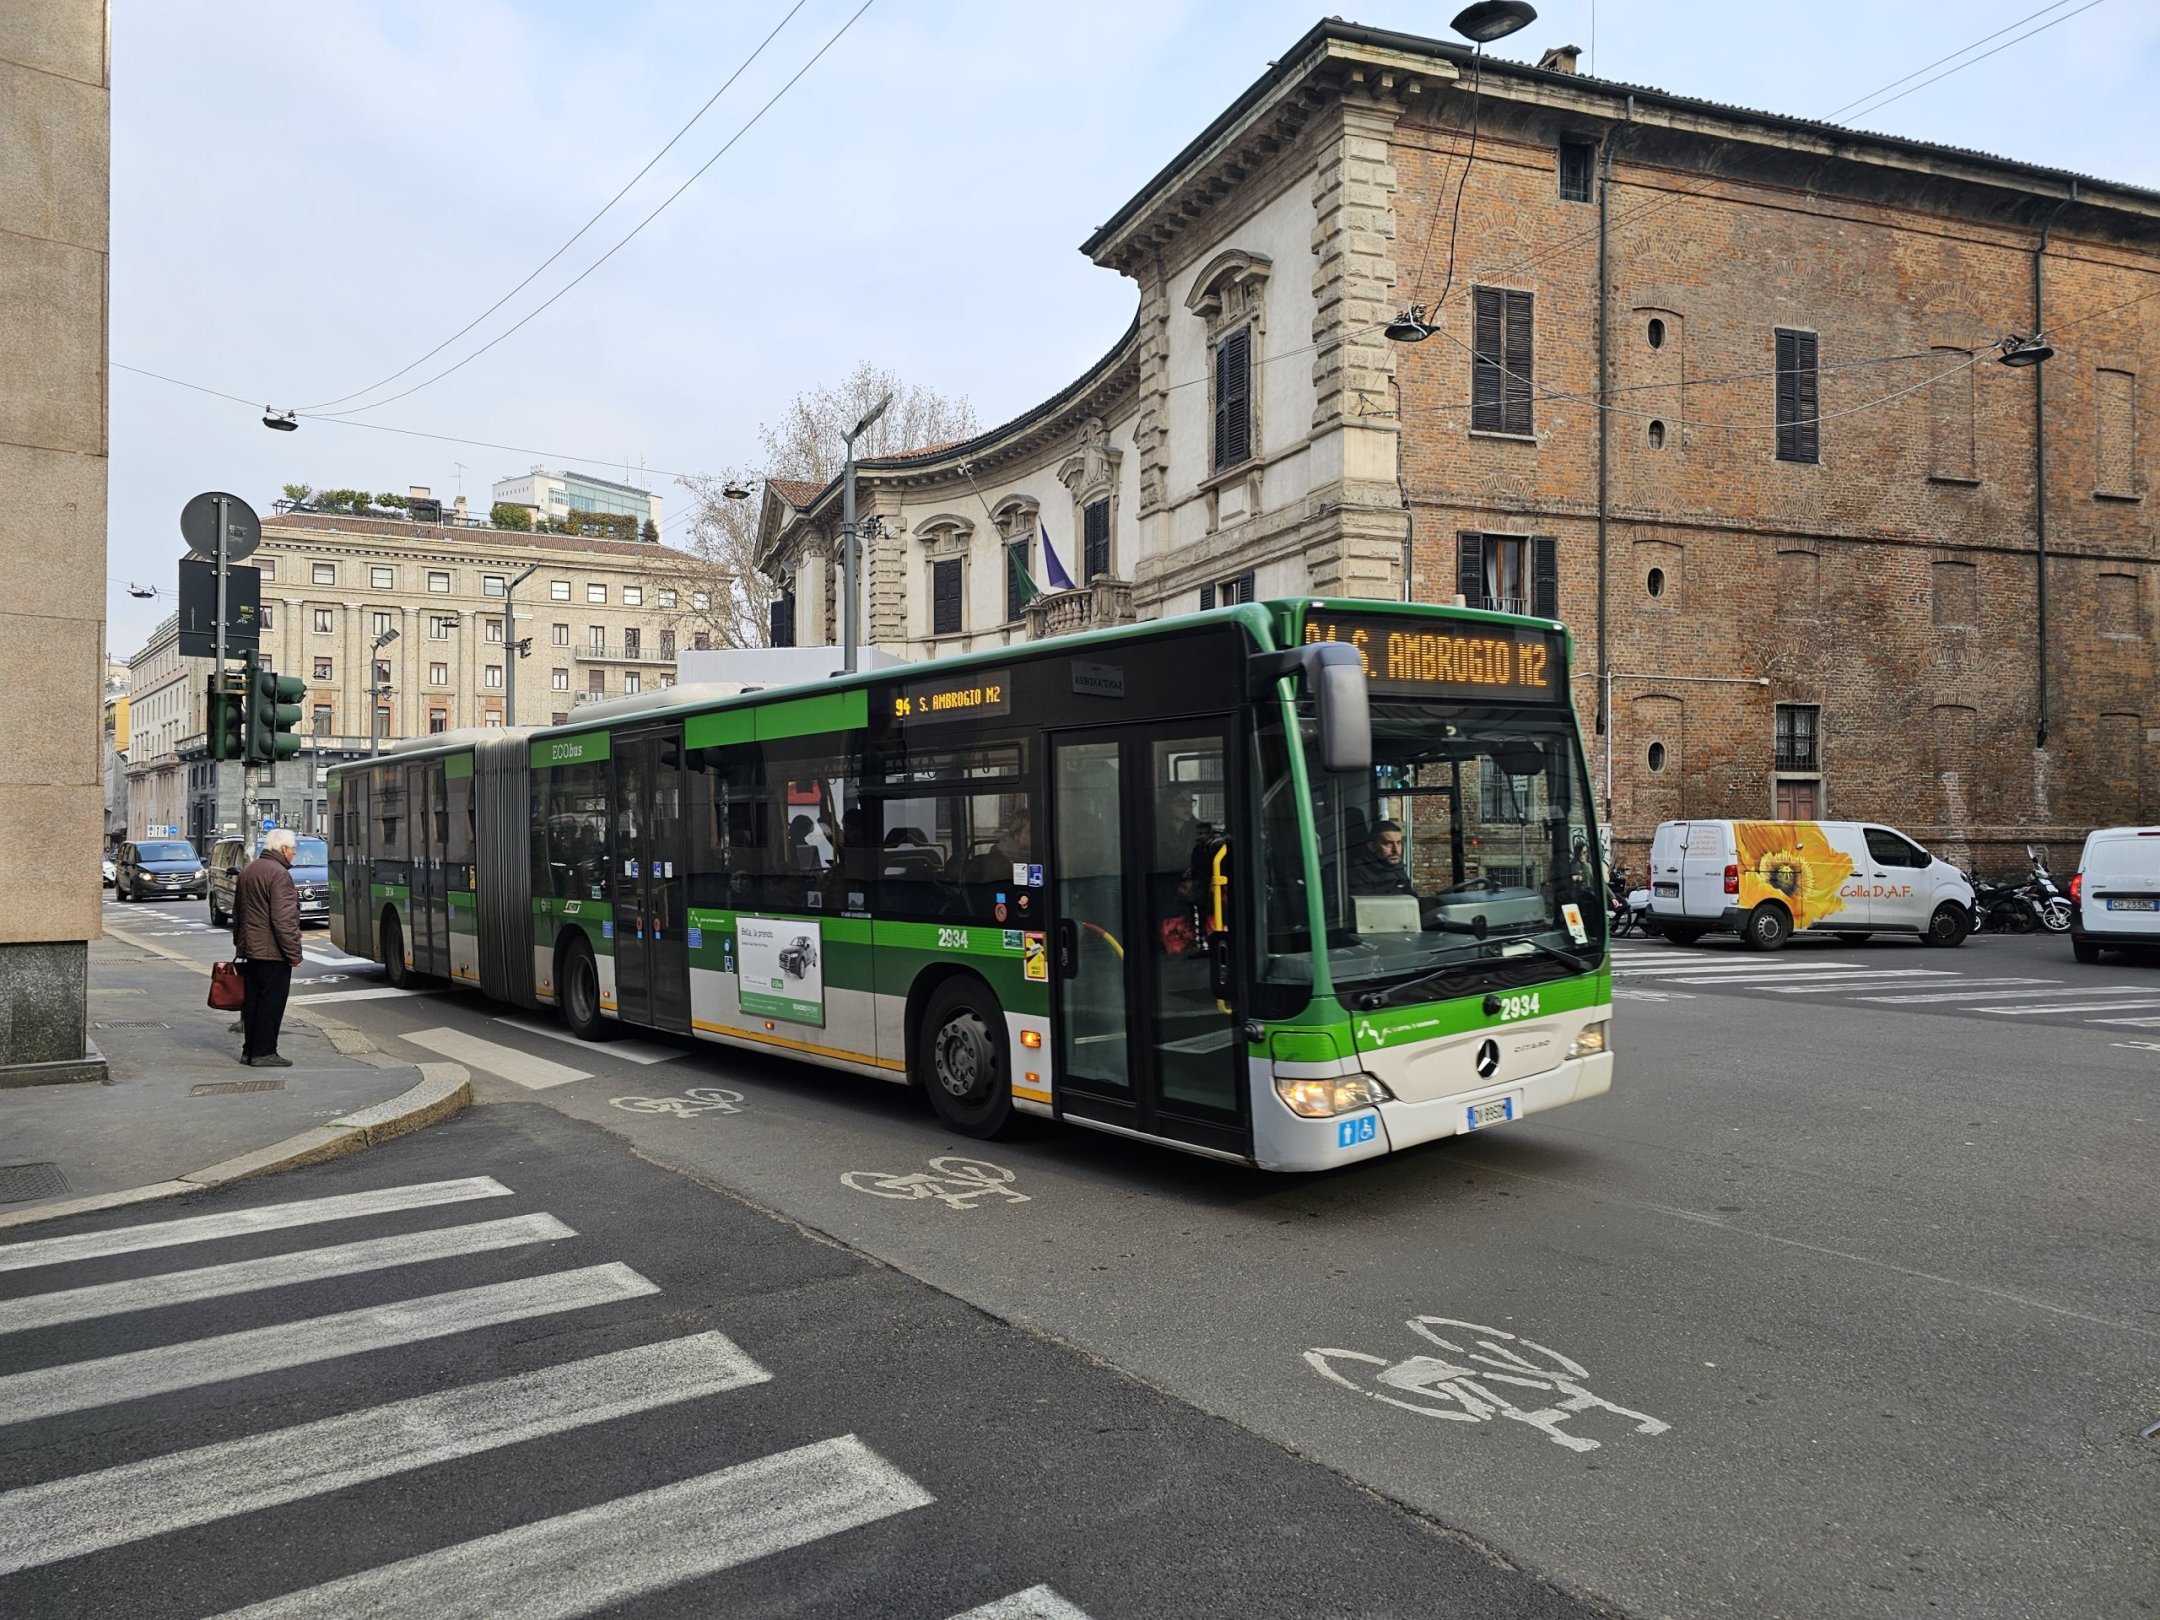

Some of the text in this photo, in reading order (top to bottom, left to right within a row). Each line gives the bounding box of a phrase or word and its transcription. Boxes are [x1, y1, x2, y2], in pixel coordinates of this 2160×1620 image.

[1388, 633, 1511, 684] AMBROGIO
[1518, 643, 1548, 686] M2
[895, 686, 1000, 716] 94 S. AMBROGIO M2
[552, 743, 583, 760] ECObus
[1840, 884, 1913, 899] Colla D.A.F.
[938, 928, 968, 949] 2934
[1501, 992, 1540, 1021] 2934
[1514, 1040, 1551, 1053] CITARO
